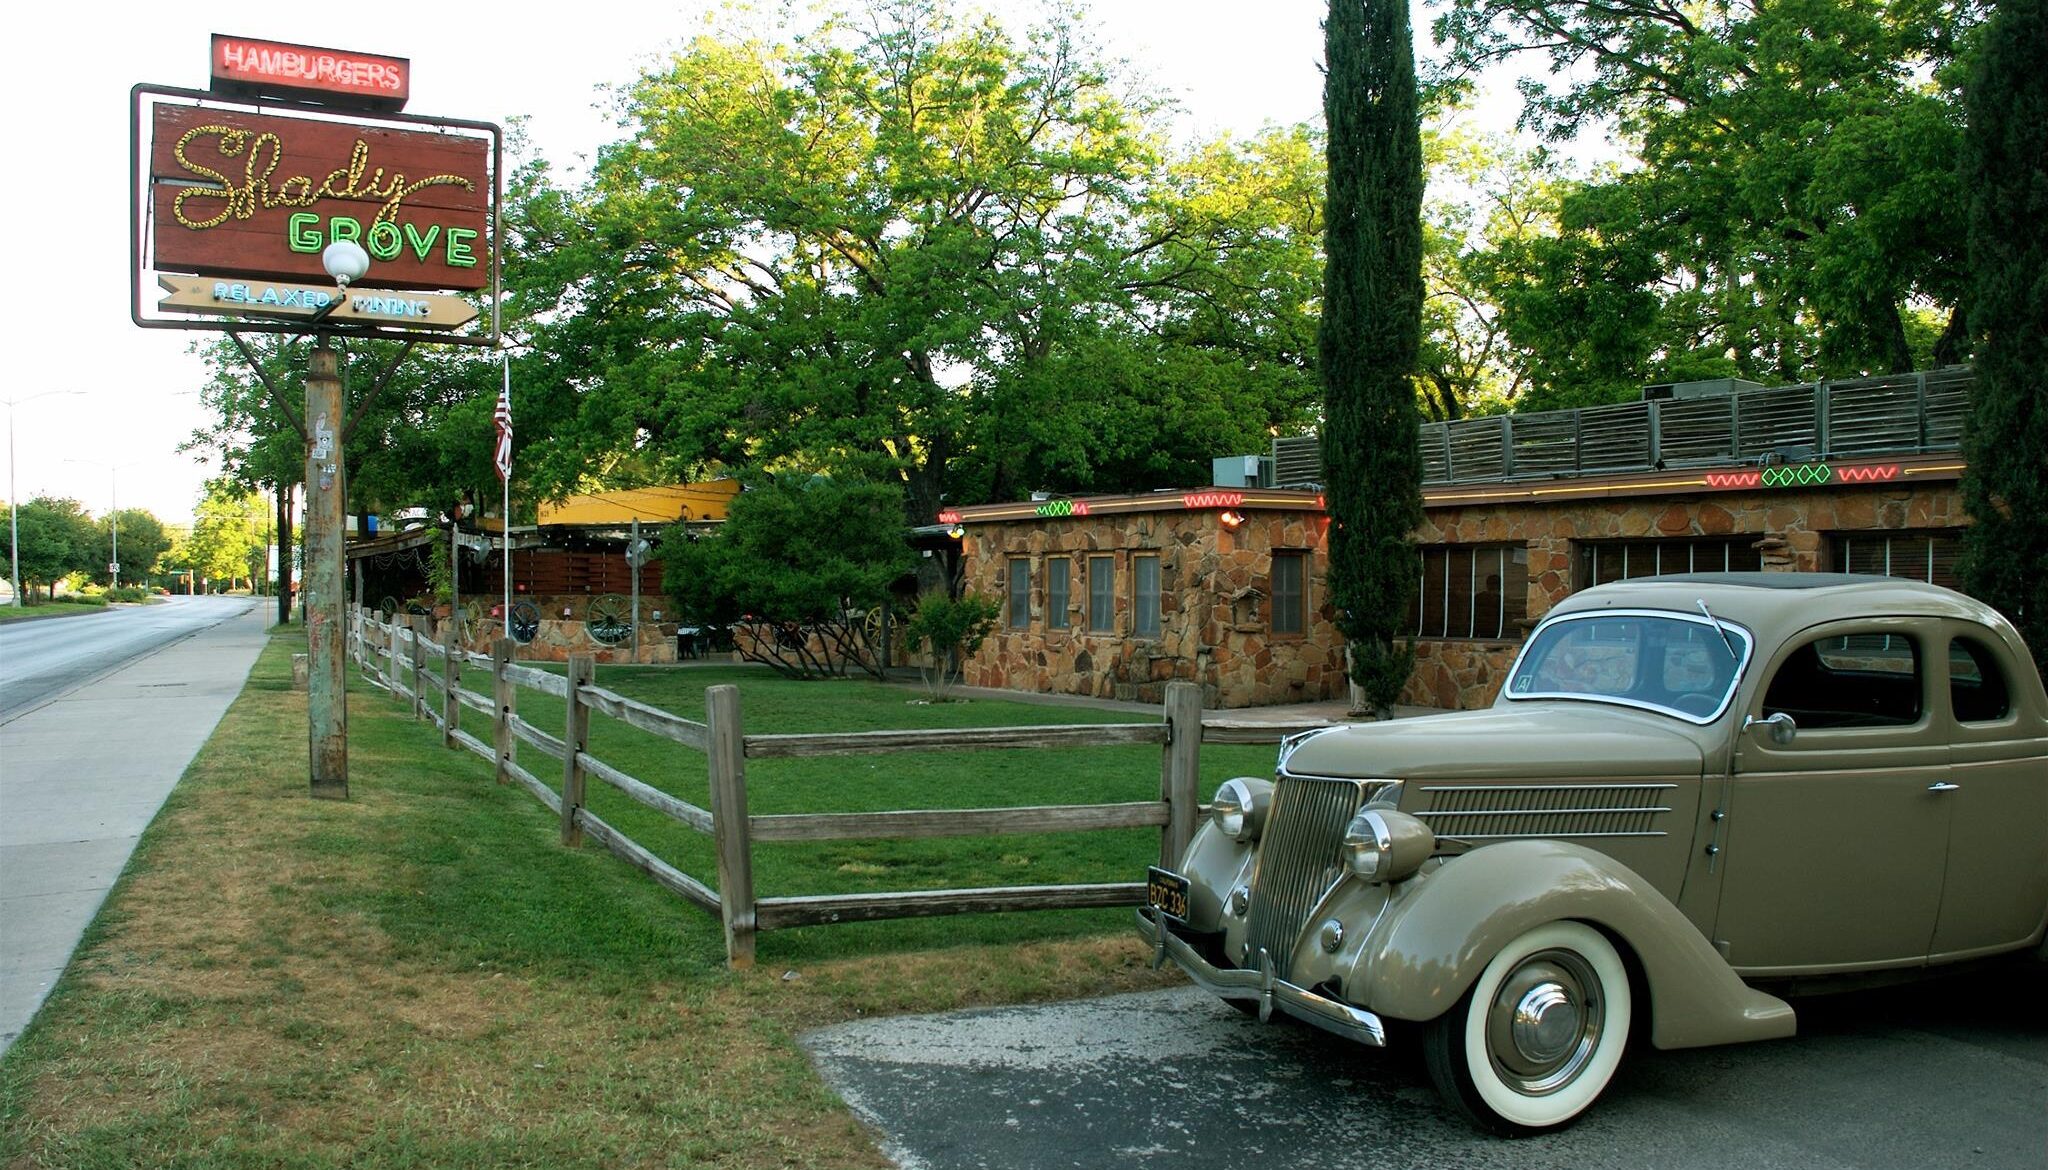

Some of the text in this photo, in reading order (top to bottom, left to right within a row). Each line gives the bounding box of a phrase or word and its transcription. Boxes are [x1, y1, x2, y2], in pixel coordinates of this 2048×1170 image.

[224, 43, 401, 90] HAMBURGERS
[174, 125, 476, 241] Shady
[289, 212, 478, 267] GROVE
[214, 282, 331, 309] RELAXED
[1170, 891, 1186, 917] 336
